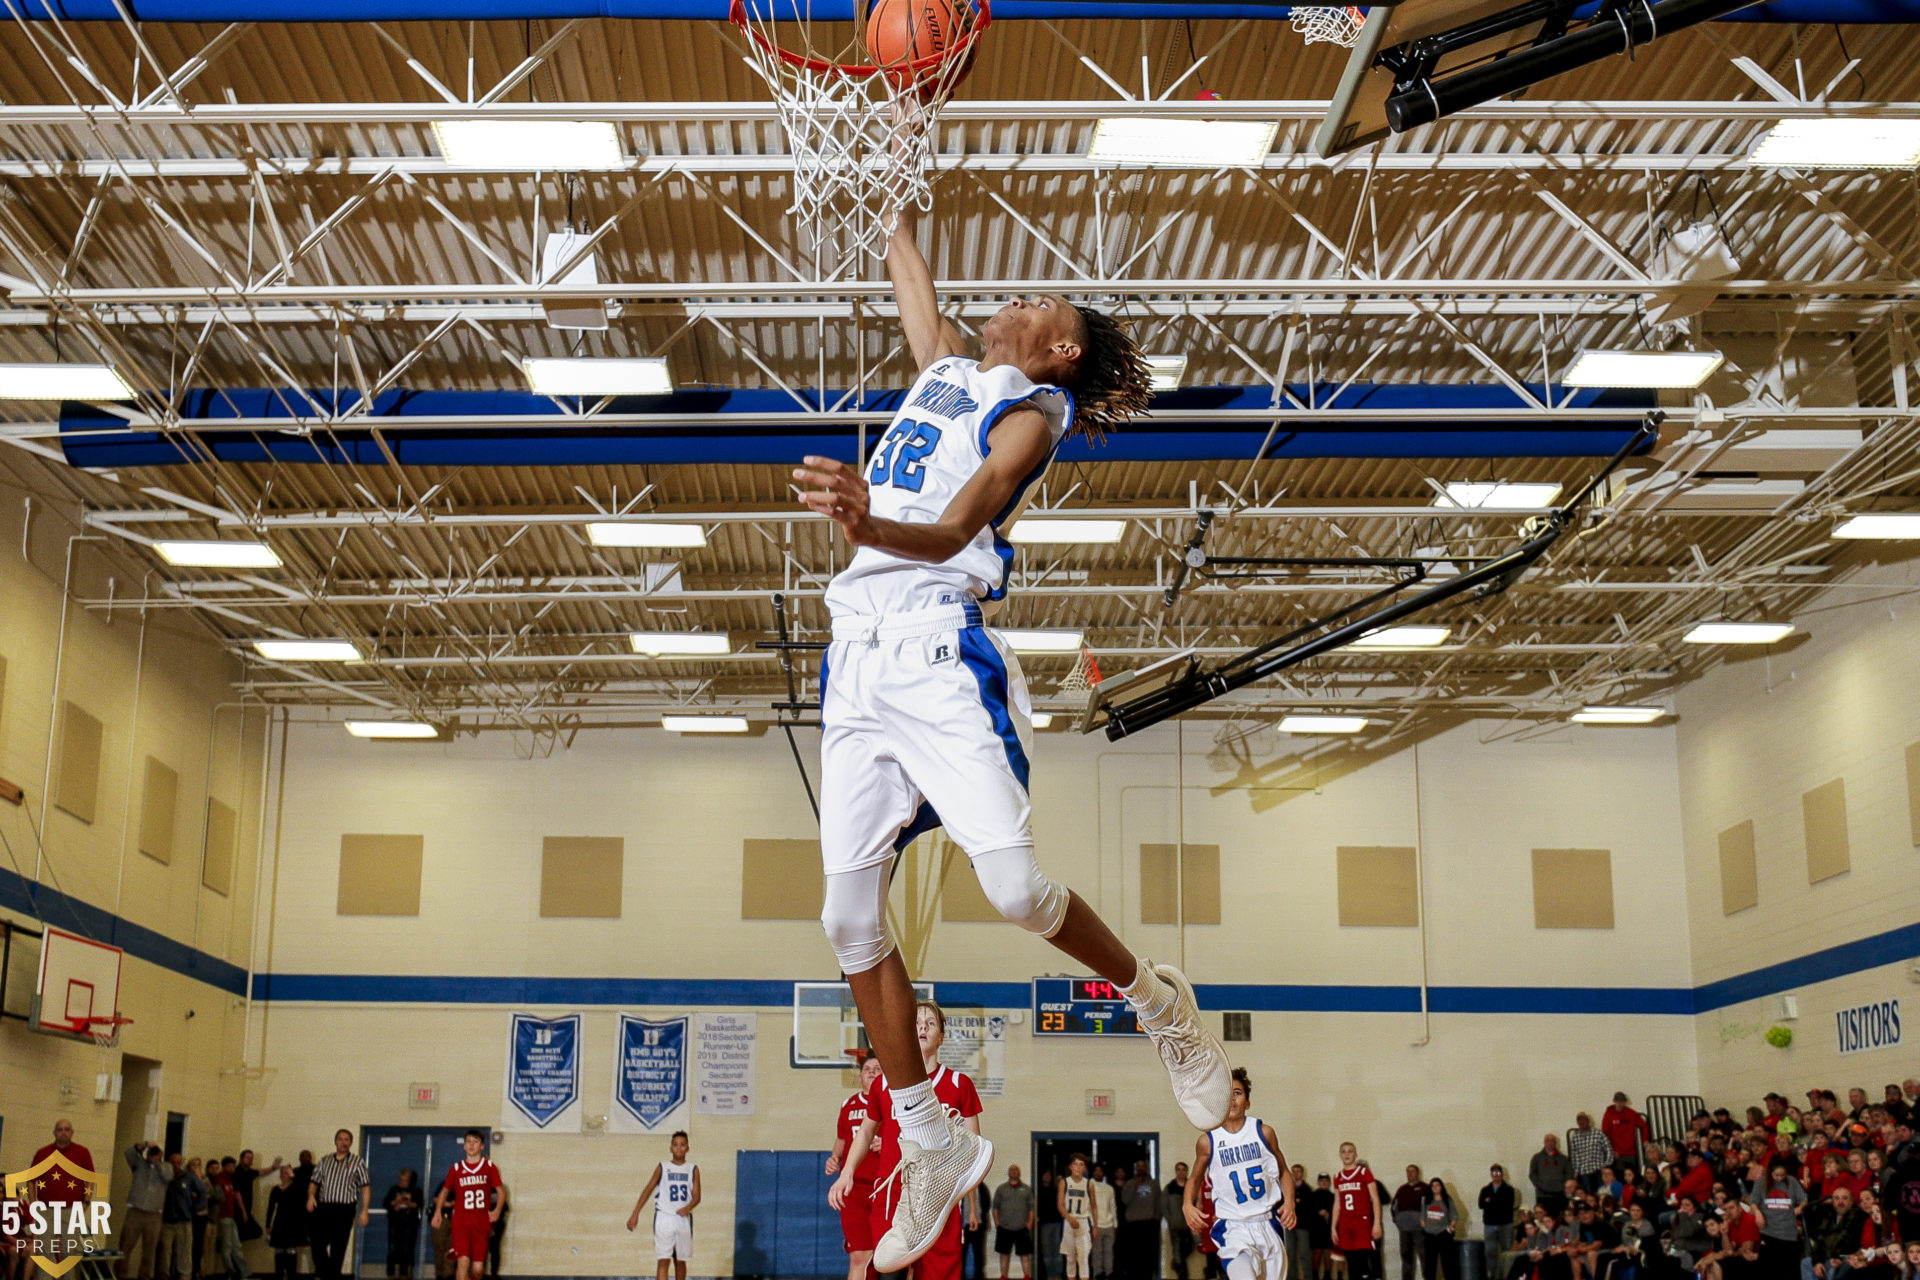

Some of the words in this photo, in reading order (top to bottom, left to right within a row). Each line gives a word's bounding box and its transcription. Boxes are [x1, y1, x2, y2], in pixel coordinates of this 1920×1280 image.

[925, 7, 945, 51] EVOLU
[870, 418, 942, 494] 32
[1040, 1003, 1074, 1012] GUEST
[705, 1023, 747, 1031] Basketball
[717, 1016, 736, 1024] Girls
[1042, 1012, 1066, 1031] 23
[1094, 1019, 1103, 1034] 3
[1836, 1000, 1900, 1052] VISITORS
[718, 1032, 755, 1041] Sectional
[703, 1041, 749, 1050] Runner-Up
[701, 1061, 748, 1070] Champions
[708, 1072, 743, 1080] Sectional
[630, 1081, 673, 1091] TOURNEY
[701, 1080, 748, 1089] Champions
[633, 1093, 670, 1102] CHAMPS
[1219, 1142, 1262, 1167] HARRIMAN
[1229, 1165, 1266, 1205] 15
[464, 1189, 485, 1210] 22
[669, 1184, 688, 1202] 23
[1068, 1198, 1082, 1214] 11
[1345, 1193, 1354, 1211] 2
